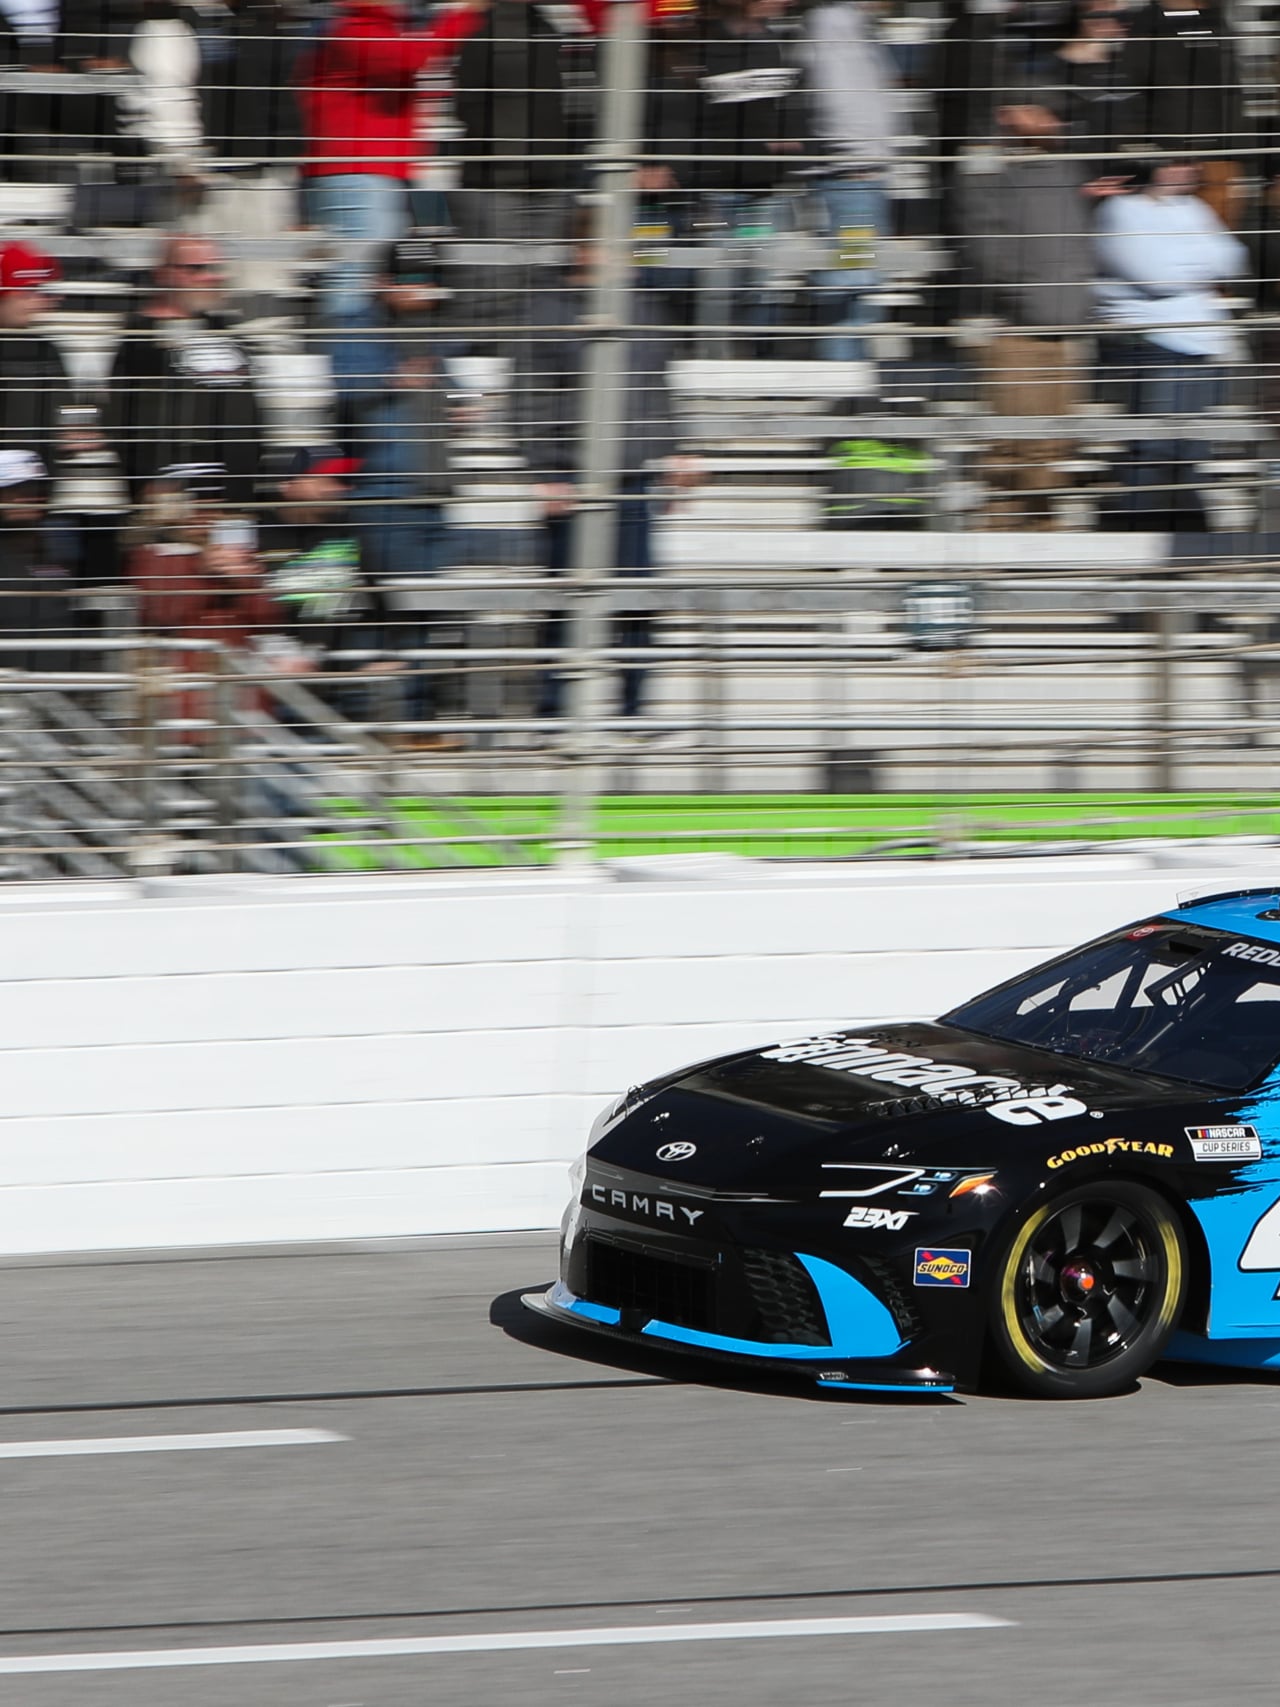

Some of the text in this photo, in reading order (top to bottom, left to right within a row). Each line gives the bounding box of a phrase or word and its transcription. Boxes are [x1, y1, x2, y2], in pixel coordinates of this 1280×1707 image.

[1209, 1127, 1246, 1138] NASCAR
[1202, 1141, 1251, 1152] CUP SERIES
[1046, 1137, 1175, 1169] GOODYEAR
[591, 1183, 705, 1226] CAMRY
[919, 1263, 966, 1274] SUNOCO
